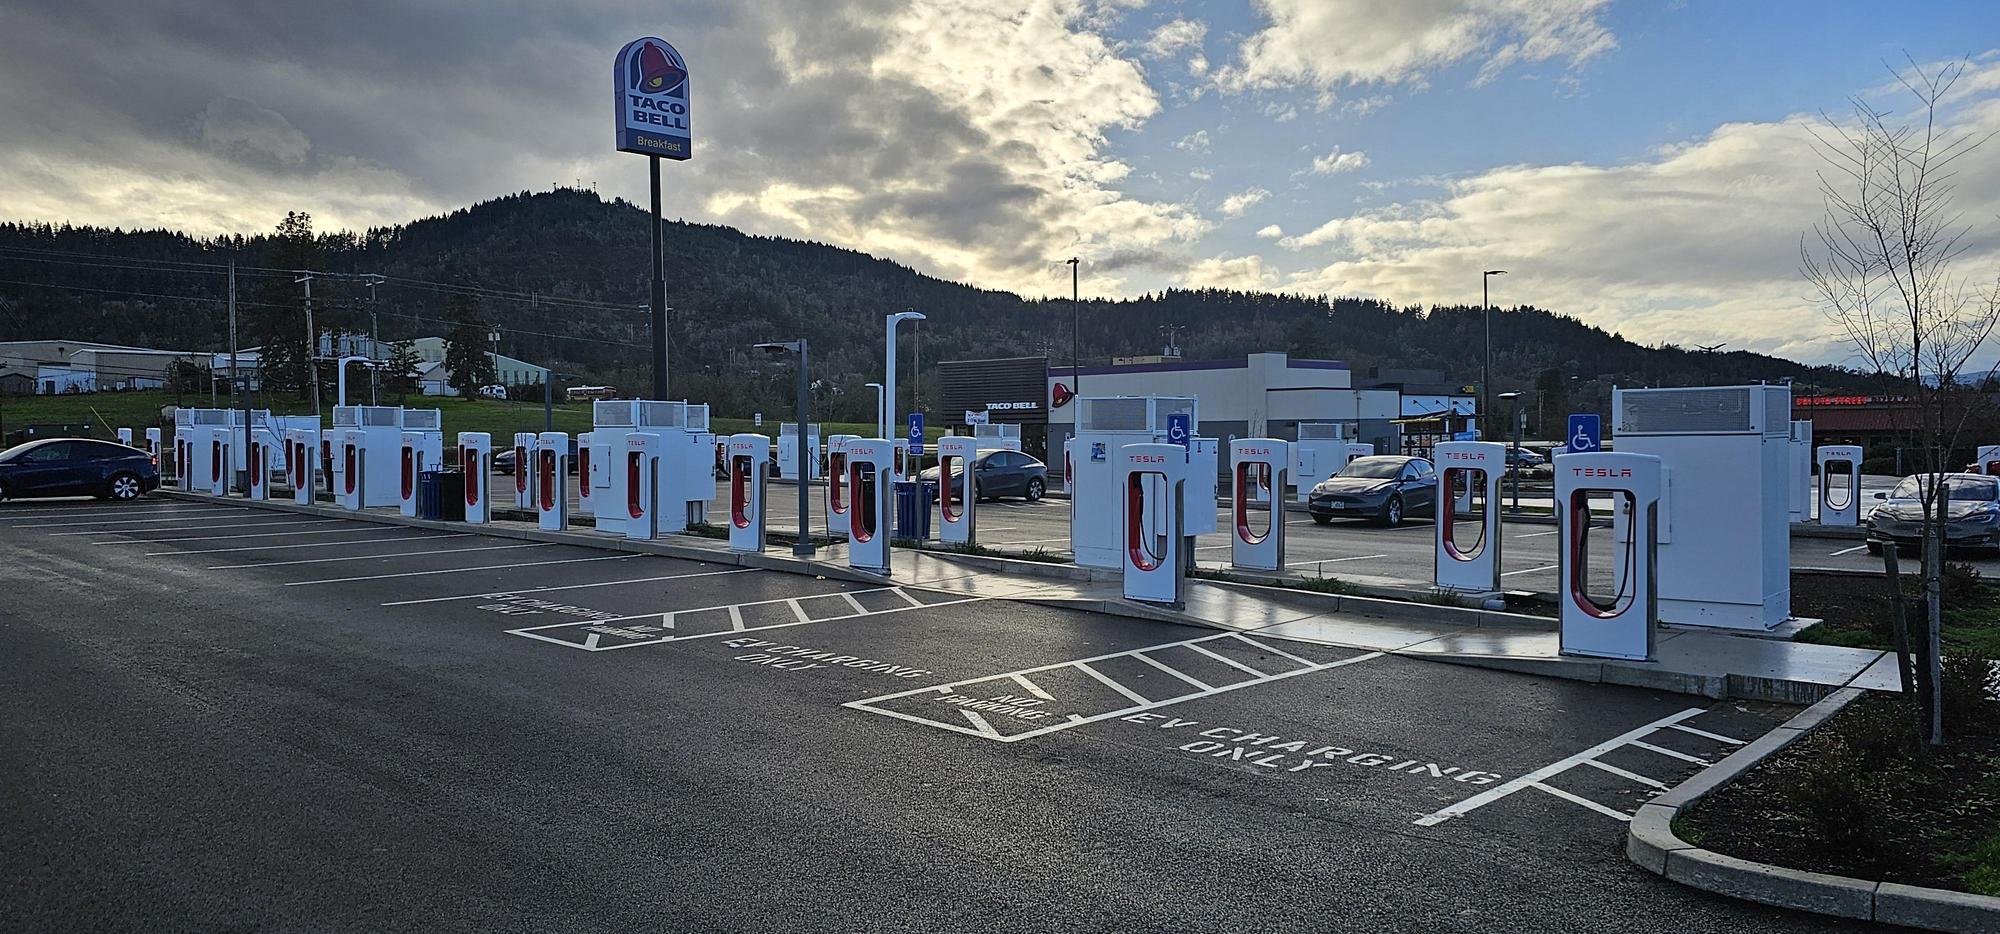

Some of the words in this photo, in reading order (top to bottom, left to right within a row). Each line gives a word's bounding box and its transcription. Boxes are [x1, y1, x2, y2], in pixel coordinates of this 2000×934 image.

[629, 94, 686, 115] TACO
[633, 110, 687, 130] BELL
[637, 136, 681, 151] Breakfast
[986, 402, 1011, 410] TACO
[1572, 468, 1632, 477] TESLA
[721, 637, 777, 648] EV
[765, 645, 932, 678] CHARGING
[734, 653, 830, 670] ONLY
[934, 694, 1051, 720] PARKING
[989, 694, 1045, 707] NO
[1121, 712, 1199, 728] EV
[1200, 727, 1501, 785] CHARGING
[1179, 740, 1333, 773] ONLY
